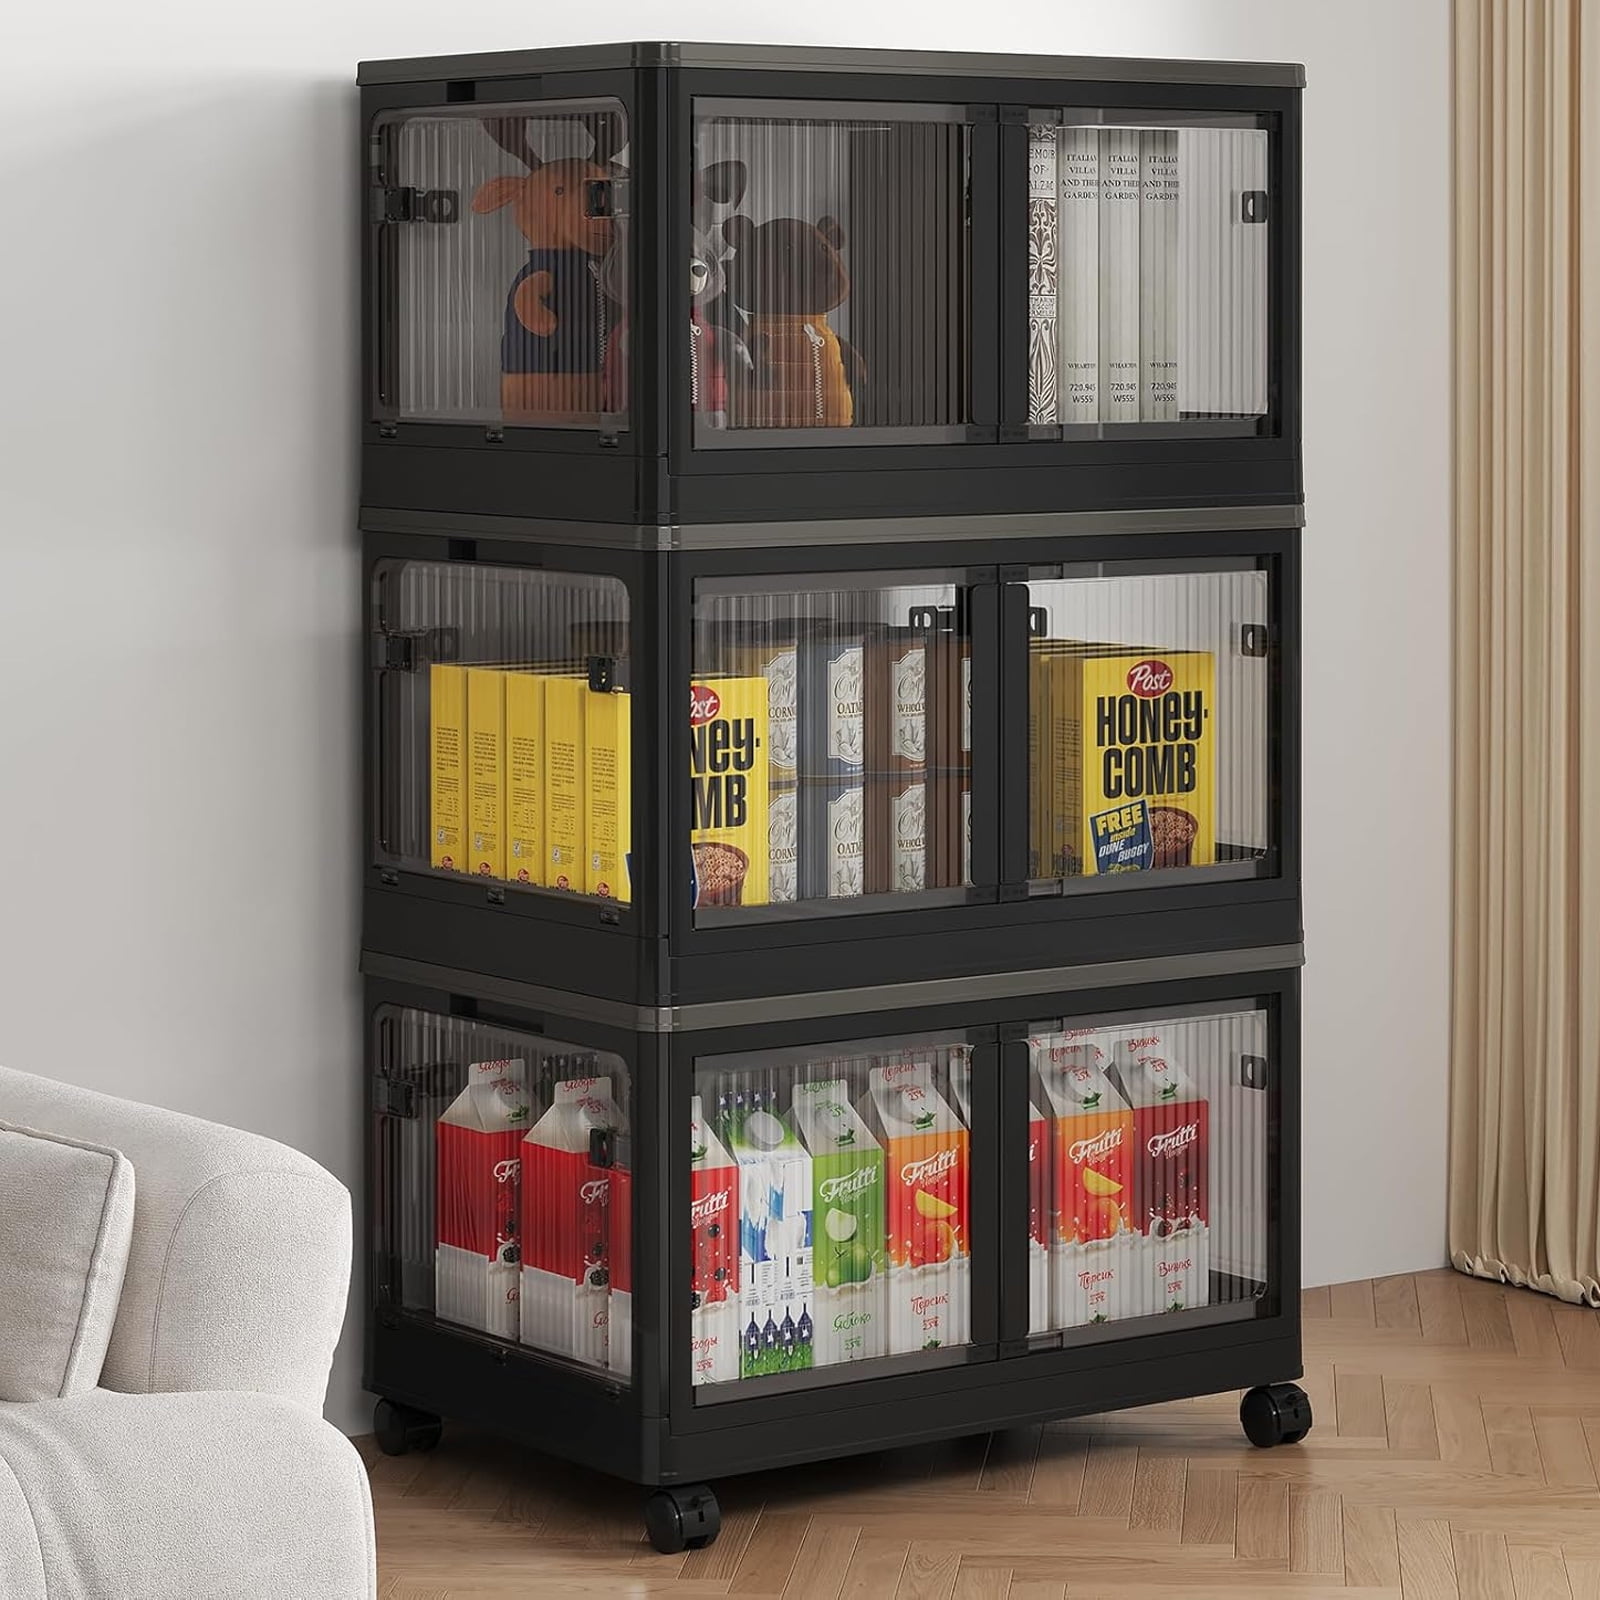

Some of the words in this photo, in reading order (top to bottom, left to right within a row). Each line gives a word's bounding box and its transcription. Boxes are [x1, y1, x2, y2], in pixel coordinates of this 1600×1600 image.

[1061, 179, 1081, 187] AND
[1102, 180, 1121, 188] AND
[1142, 180, 1161, 188] AND
[1129, 664, 1171, 692] Post
[1103, 743, 1197, 799] COMB
[691, 774, 747, 831] MB
[1095, 803, 1143, 837] FREE
[1098, 838, 1126, 858] DUNE
[1117, 842, 1150, 863] BUGGY
[1069, 1127, 1124, 1165] Frutti
[1147, 1122, 1199, 1158] Frutti
[900, 1148, 959, 1187] Frutti
[819, 1164, 879, 1204] Frutti
[691, 1187, 730, 1218] rutti
